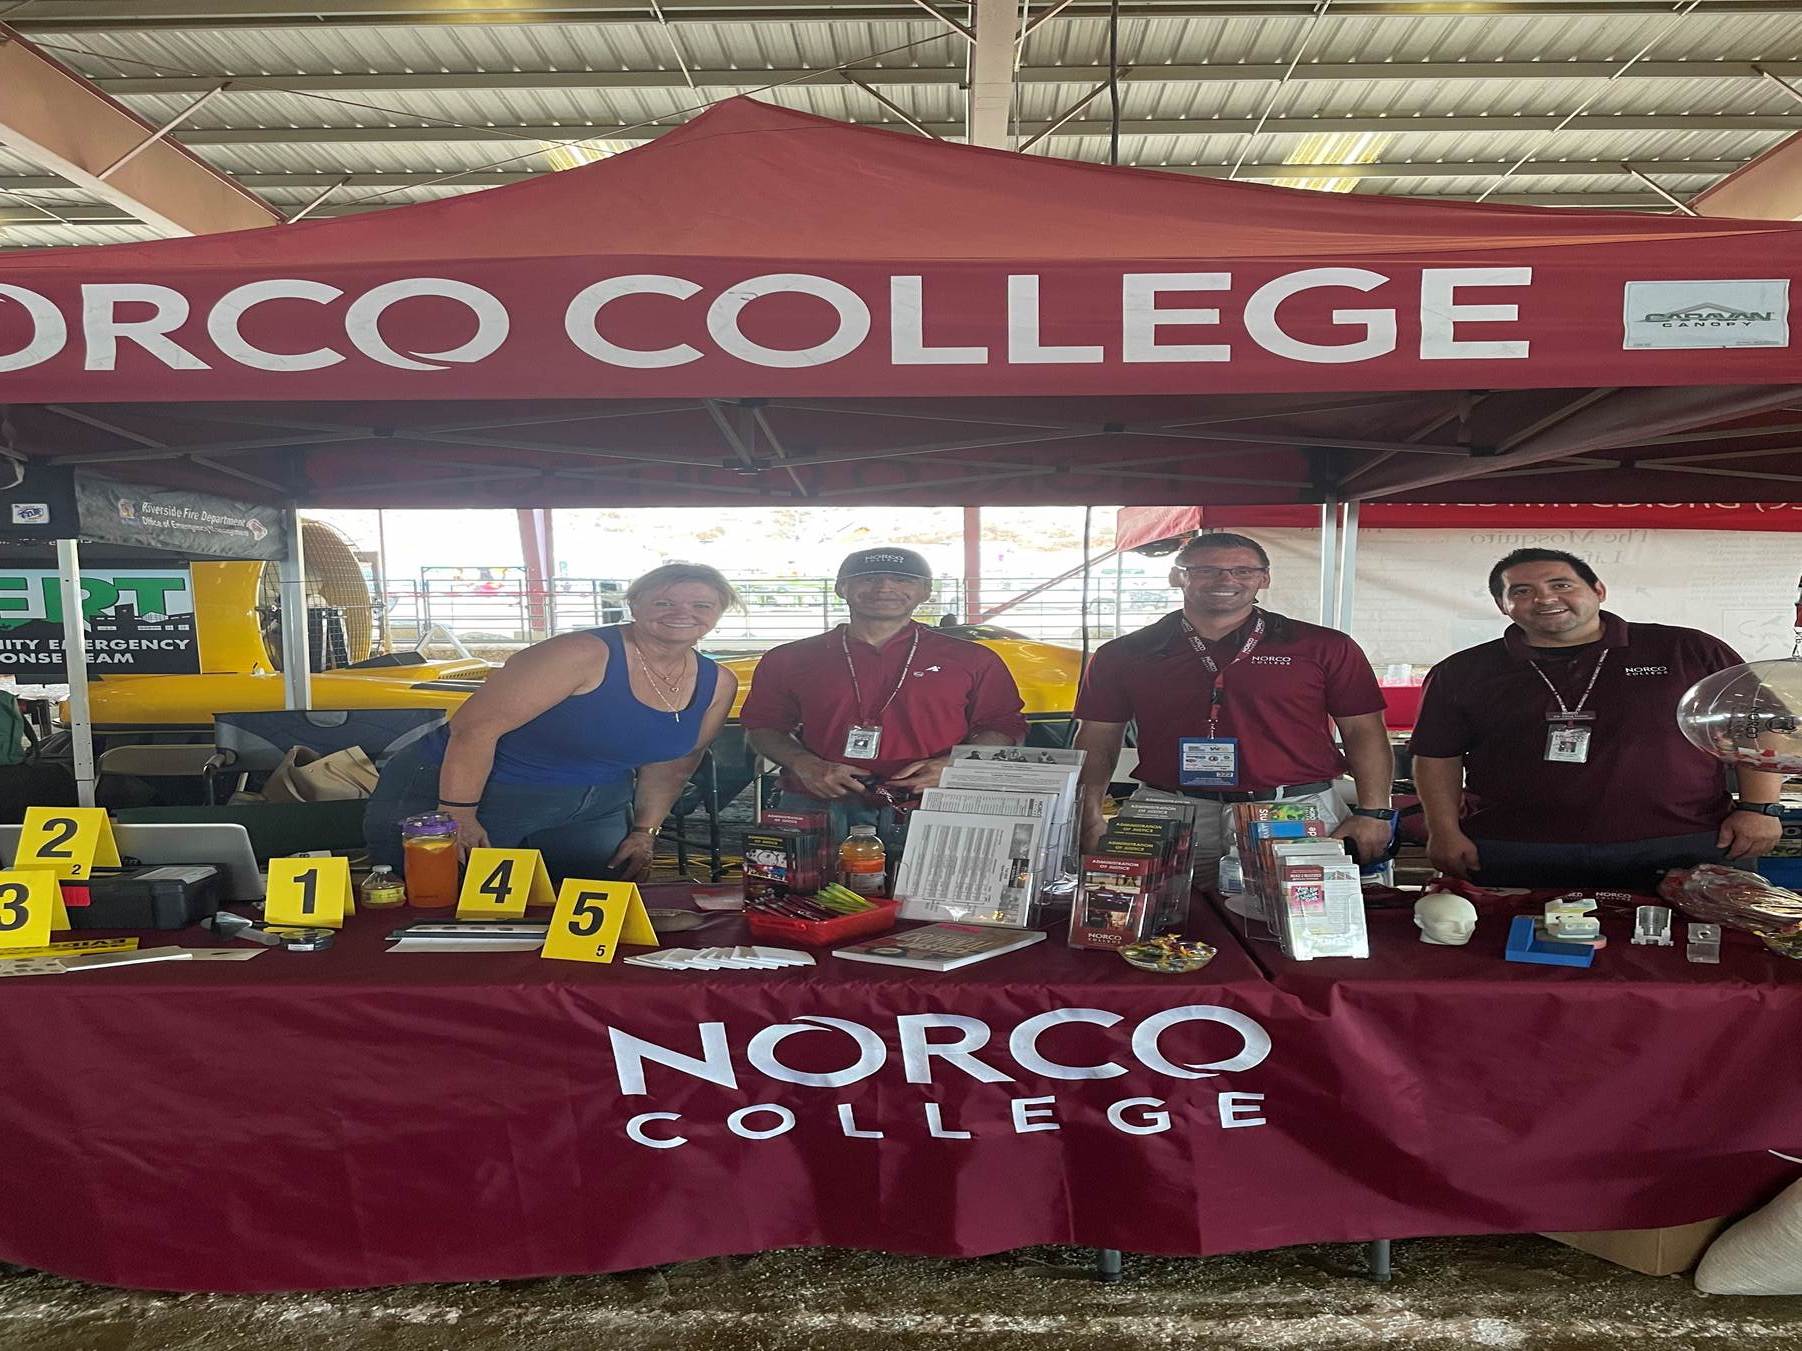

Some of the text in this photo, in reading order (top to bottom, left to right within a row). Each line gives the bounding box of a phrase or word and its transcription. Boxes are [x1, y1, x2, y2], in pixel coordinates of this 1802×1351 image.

[565, 266, 1532, 369] COLLEGE
[141, 501, 246, 528] Riverside Fire Department
[142, 516, 162, 528] Office
[163, 519, 171, 528] of
[49, 639, 191, 650] EERGENCY
[0, 652, 134, 664] ONSE EAM
[36, 817, 79, 859] 2
[1108, 840, 1154, 848] ADMINISTRATION
[71, 863, 81, 875] 2
[1092, 859, 1140, 867] ADMINISTRATION
[293, 868, 319, 914] 1
[479, 859, 513, 904] 4
[1595, 891, 1632, 899] NORCO
[0, 883, 30, 931] 3
[567, 891, 609, 937] 5
[1088, 932, 1122, 941] NORCO
[596, 944, 606, 957] 5
[608, 1004, 1272, 1096] NORCO
[626, 1091, 1267, 1150] COLLEGE
